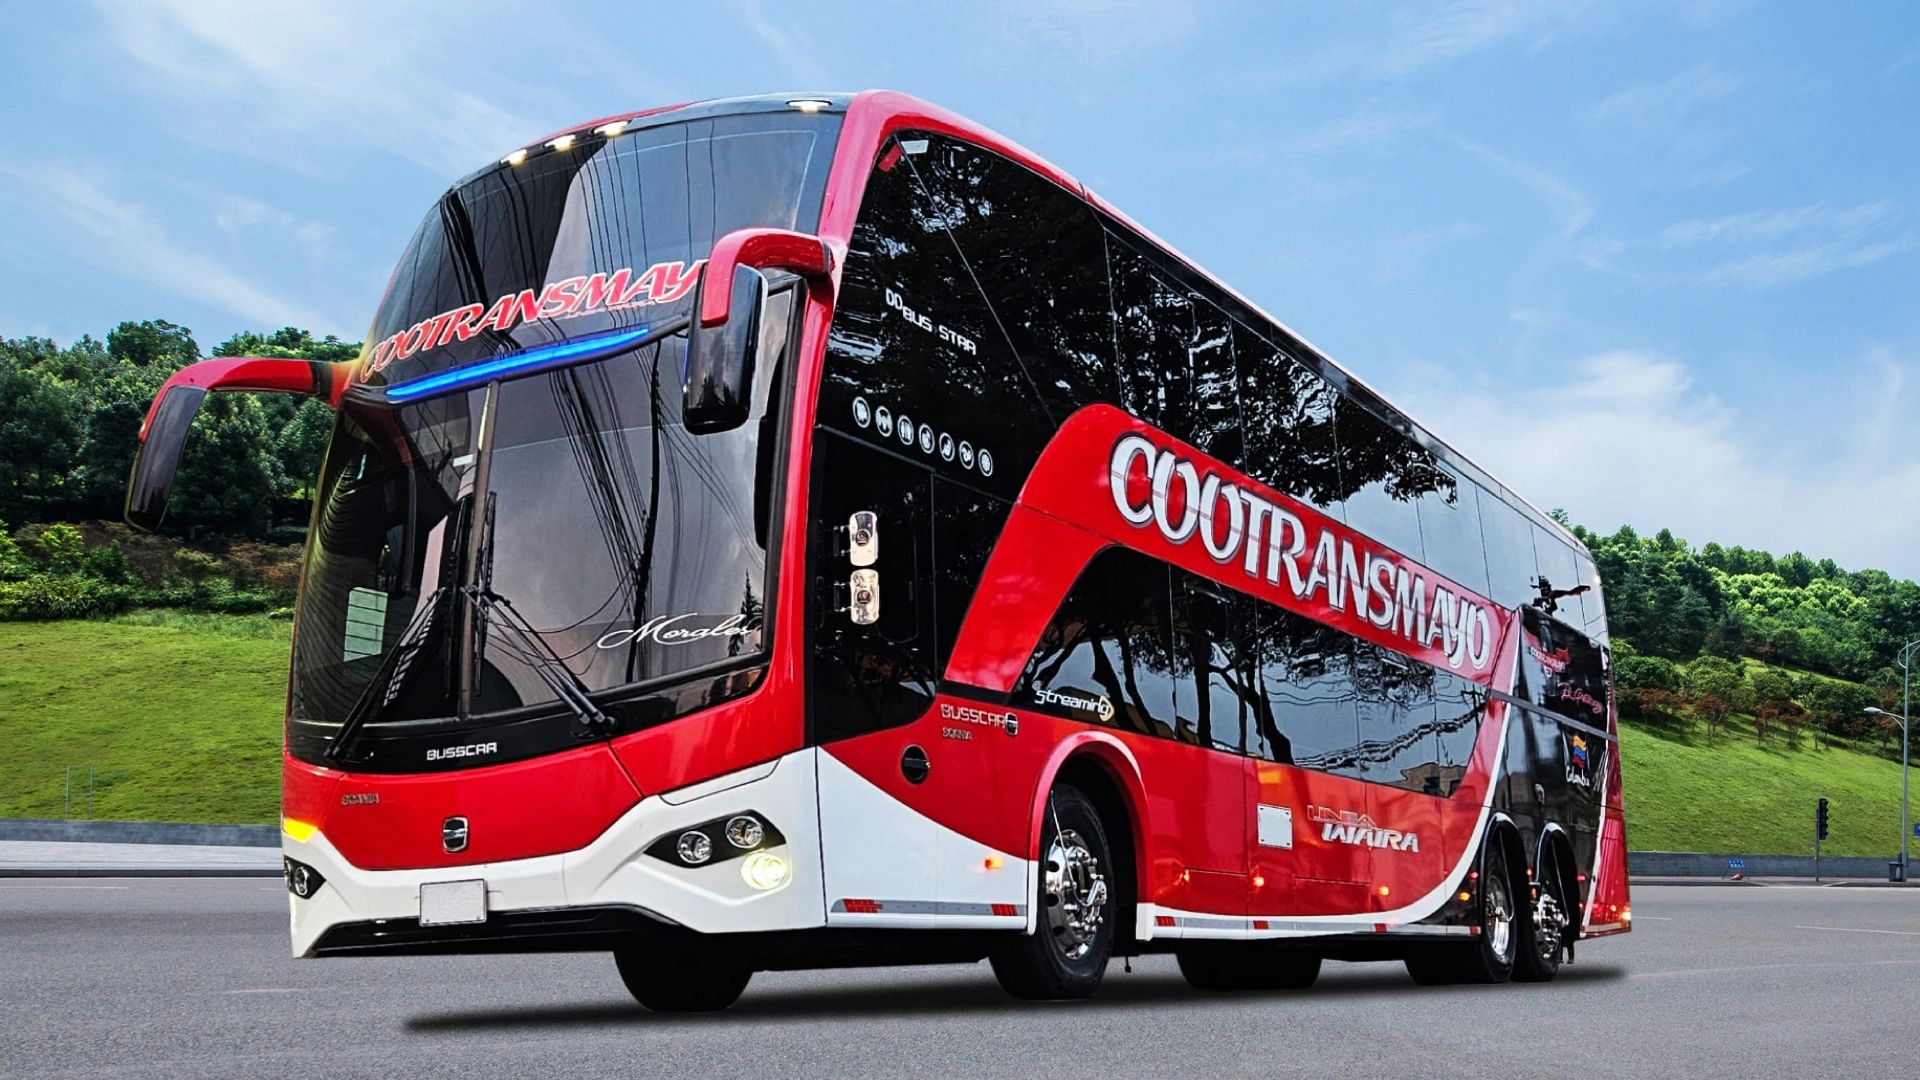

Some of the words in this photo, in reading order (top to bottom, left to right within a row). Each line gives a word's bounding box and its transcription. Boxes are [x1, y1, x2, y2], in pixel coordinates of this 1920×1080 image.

[360, 259, 708, 383] COOTRANSMAY
[938, 324, 977, 356] STAR
[1108, 431, 1493, 671] COOTRANSMAYO
[596, 612, 754, 649] Morales
[940, 703, 1006, 729] BUSSCAR
[942, 727, 973, 741] SCANIA
[426, 742, 498, 761] BUSSCAR
[341, 792, 380, 806] SCANIA
[1321, 822, 1420, 853] WAIRA
